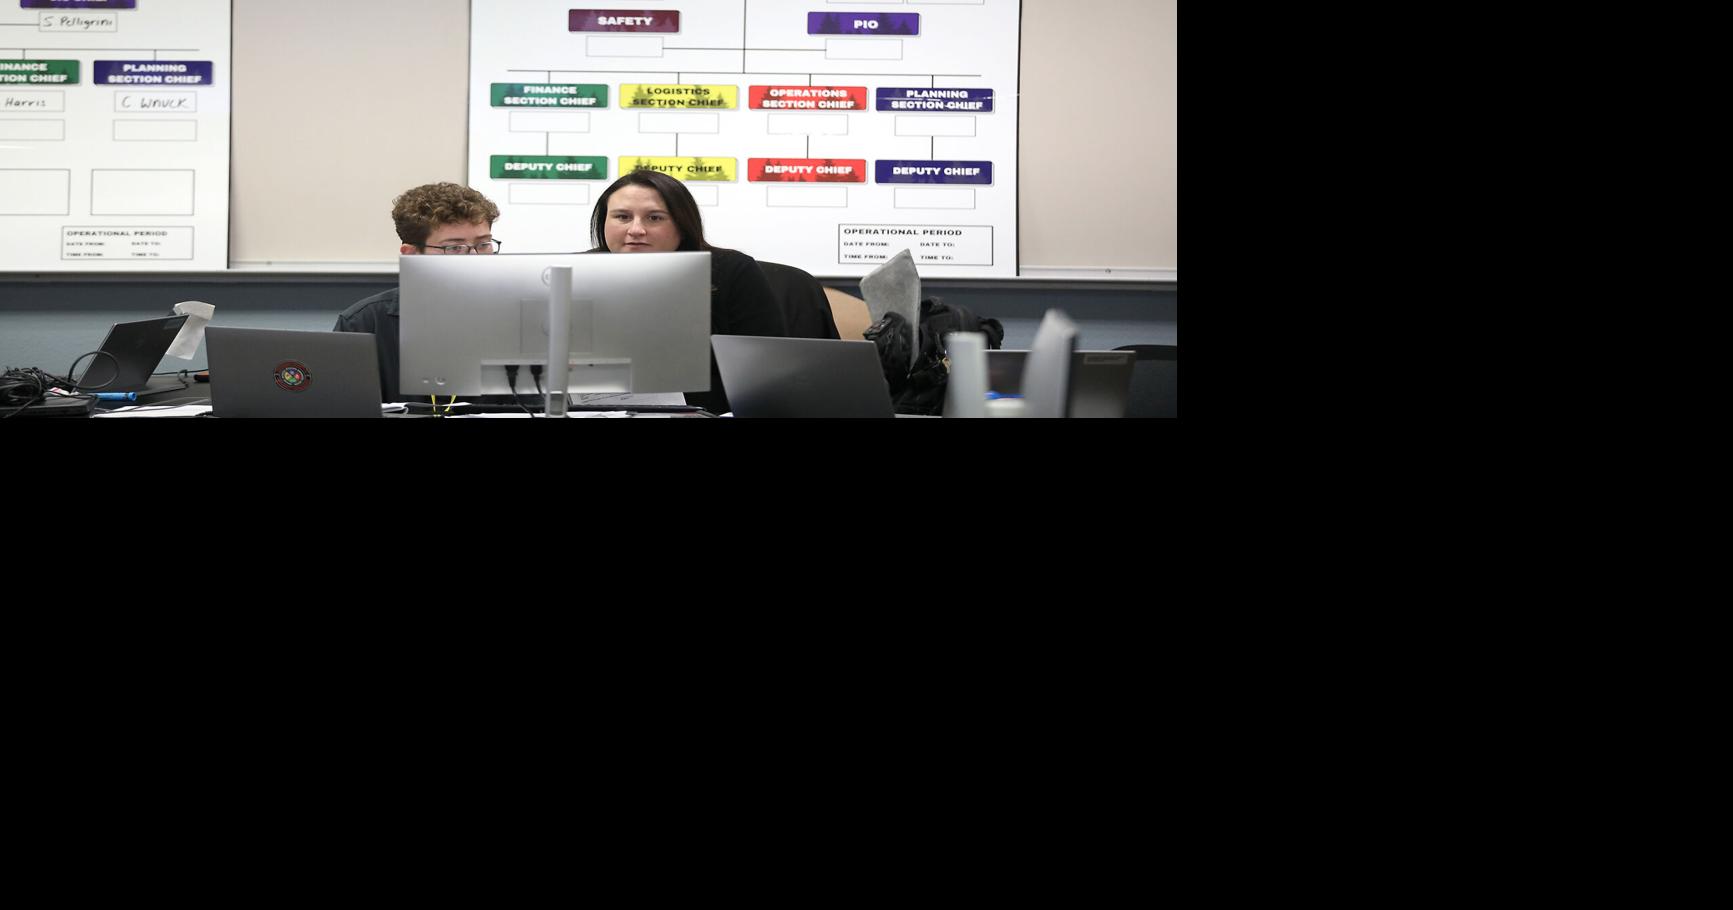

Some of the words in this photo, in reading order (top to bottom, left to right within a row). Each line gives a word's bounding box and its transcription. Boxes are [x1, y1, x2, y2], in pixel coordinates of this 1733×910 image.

[598, 16, 652, 26] SAFETY
[853, 20, 879, 29] PIO
[0, 63, 48, 71] INANCE
[123, 64, 187, 73] PLANNING
[0, 74, 27, 82] TION
[29, 74, 68, 83] CHIEF
[107, 75, 161, 83] SECTION
[164, 75, 202, 84] CHIEF
[523, 86, 577, 95] FINANCE
[646, 87, 711, 96] LOGISTICS
[769, 89, 847, 98] OPERATIONS
[906, 90, 969, 99] PLANNING
[503, 97, 557, 105] SECTION
[560, 97, 597, 106] CHIEF
[632, 98, 685, 107] SECTION
[688, 98, 724, 107] CHIEF
[762, 100, 817, 109] SECTION
[818, 100, 855, 109] CHIEF
[891, 101, 945, 110] SECTION
[948, 101, 983, 110] CHIEF
[504, 162, 553, 172] DEPUTY
[556, 162, 593, 172] CHIEF
[687, 165, 723, 173] CHIEF
[765, 165, 814, 174] DEPUTY
[816, 165, 853, 174] CHIEF
[893, 166, 941, 176] DEPUTY
[943, 166, 980, 176] CHIEF
[843, 228, 919, 236] OPERATIONAL
